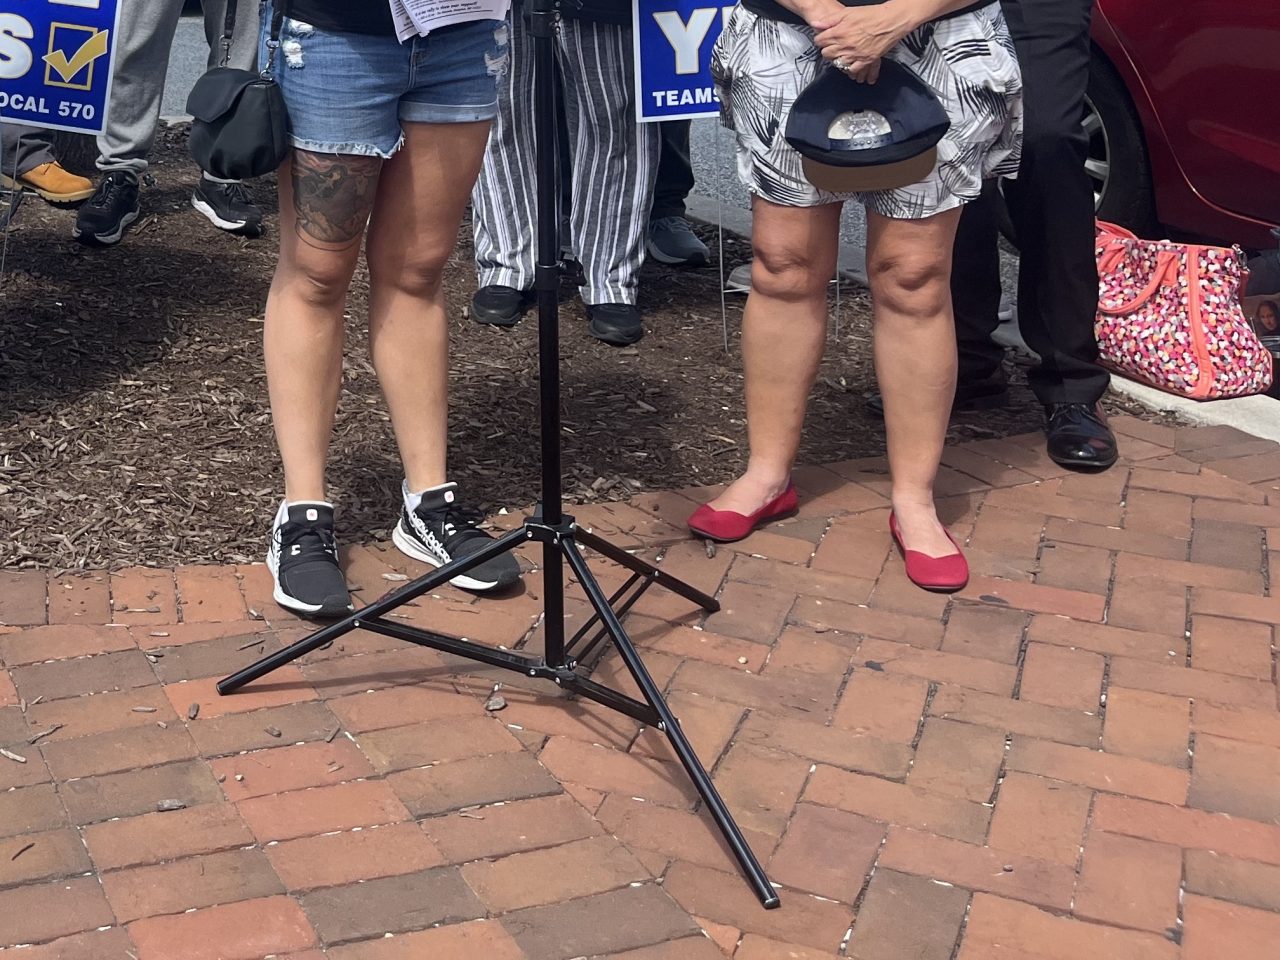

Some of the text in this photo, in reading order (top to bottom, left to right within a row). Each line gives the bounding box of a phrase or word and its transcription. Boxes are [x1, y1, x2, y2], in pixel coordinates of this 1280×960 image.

[0, 93, 96, 121] OCAL 570
[652, 87, 724, 107] TEAMS
